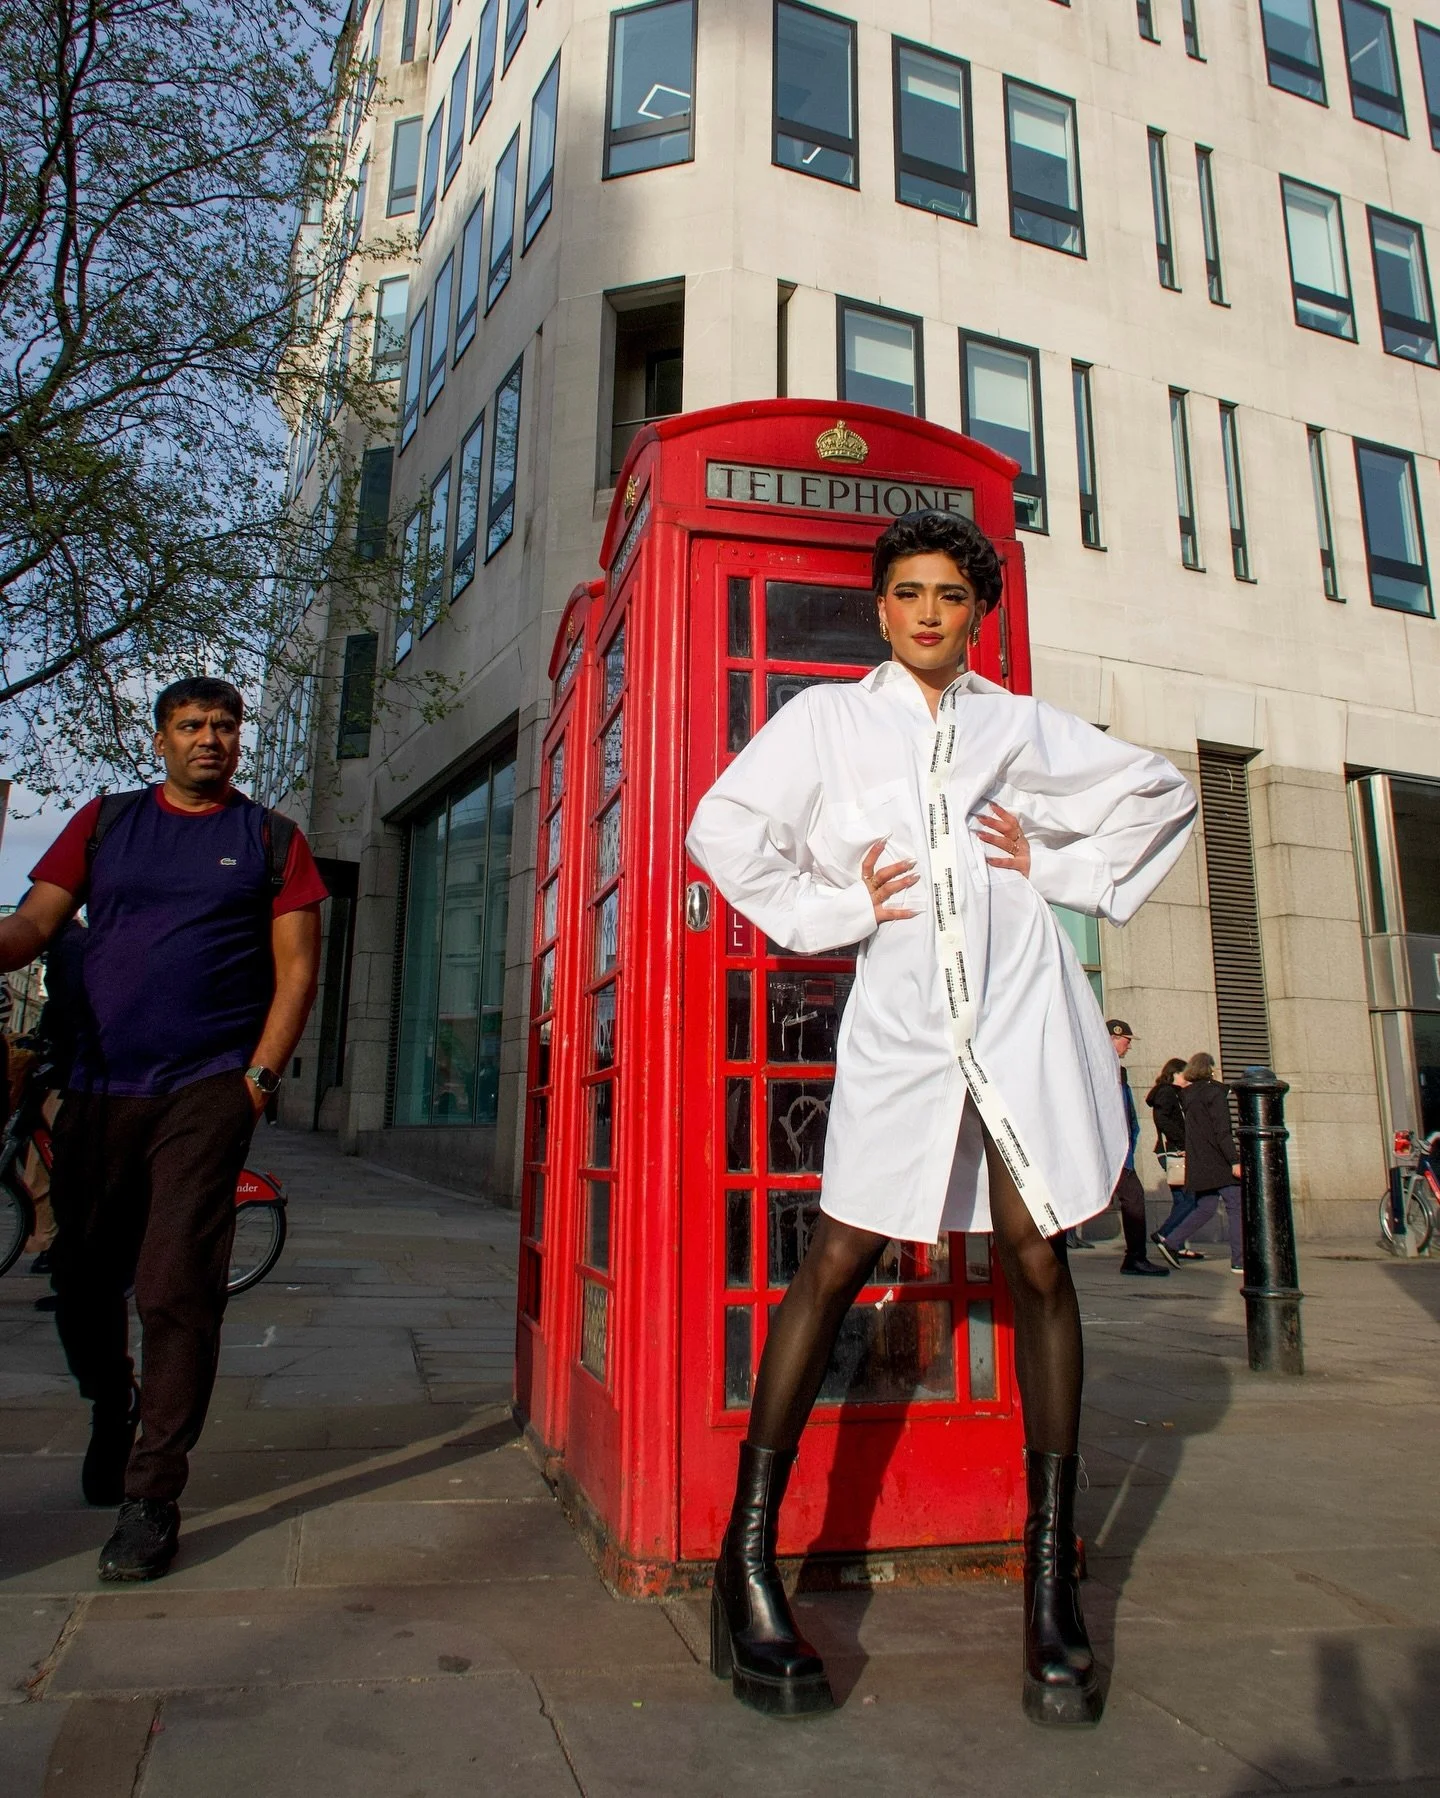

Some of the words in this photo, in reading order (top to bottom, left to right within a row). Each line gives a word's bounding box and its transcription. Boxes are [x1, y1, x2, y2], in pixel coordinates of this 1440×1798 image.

[716, 467, 962, 517] TELEPHONE
[733, 913, 743, 946] LL
[236, 1182, 259, 1193] nder
